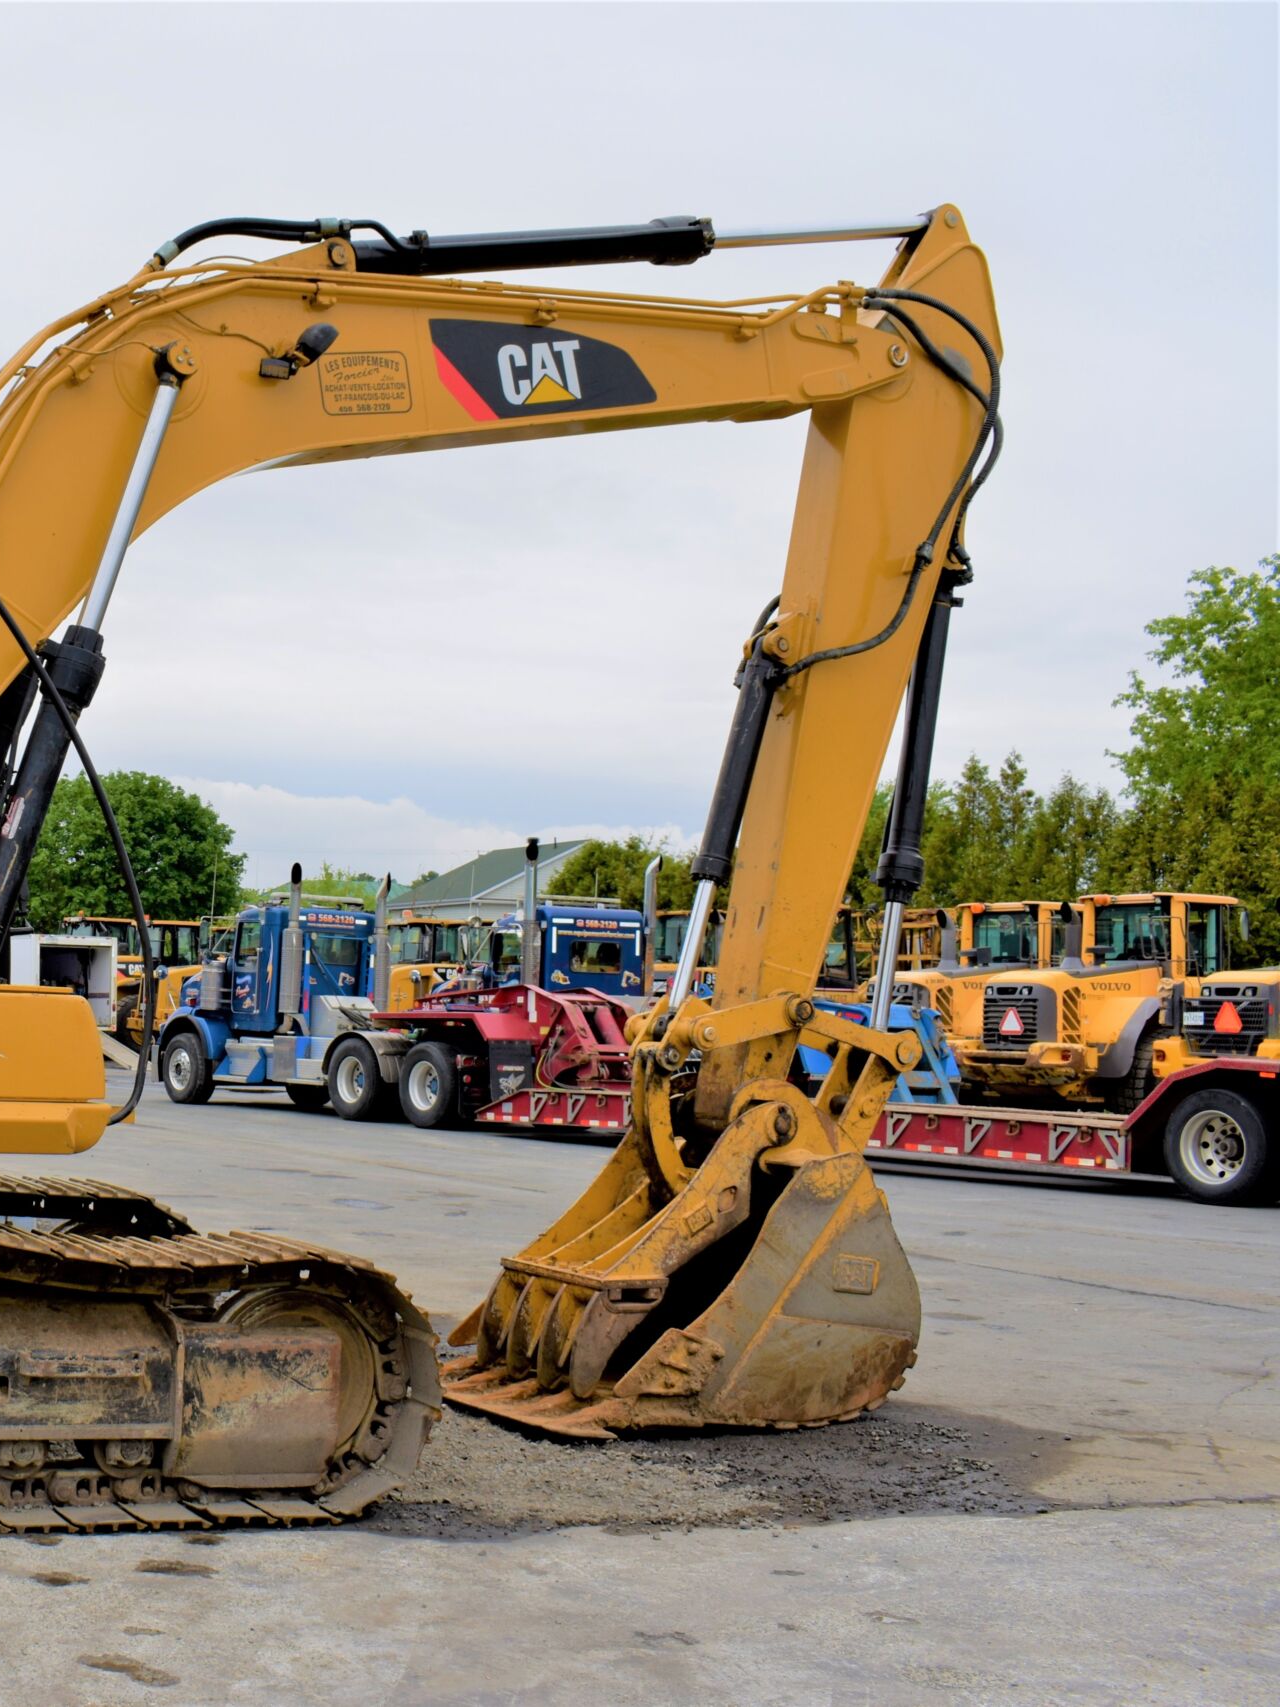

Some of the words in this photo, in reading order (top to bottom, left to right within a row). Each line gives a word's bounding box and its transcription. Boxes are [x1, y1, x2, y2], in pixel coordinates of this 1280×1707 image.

[325, 359, 340, 373] LES
[497, 340, 582, 406] CAT
[962, 981, 985, 991] VOL
[1090, 982, 1132, 992] VOLVO
